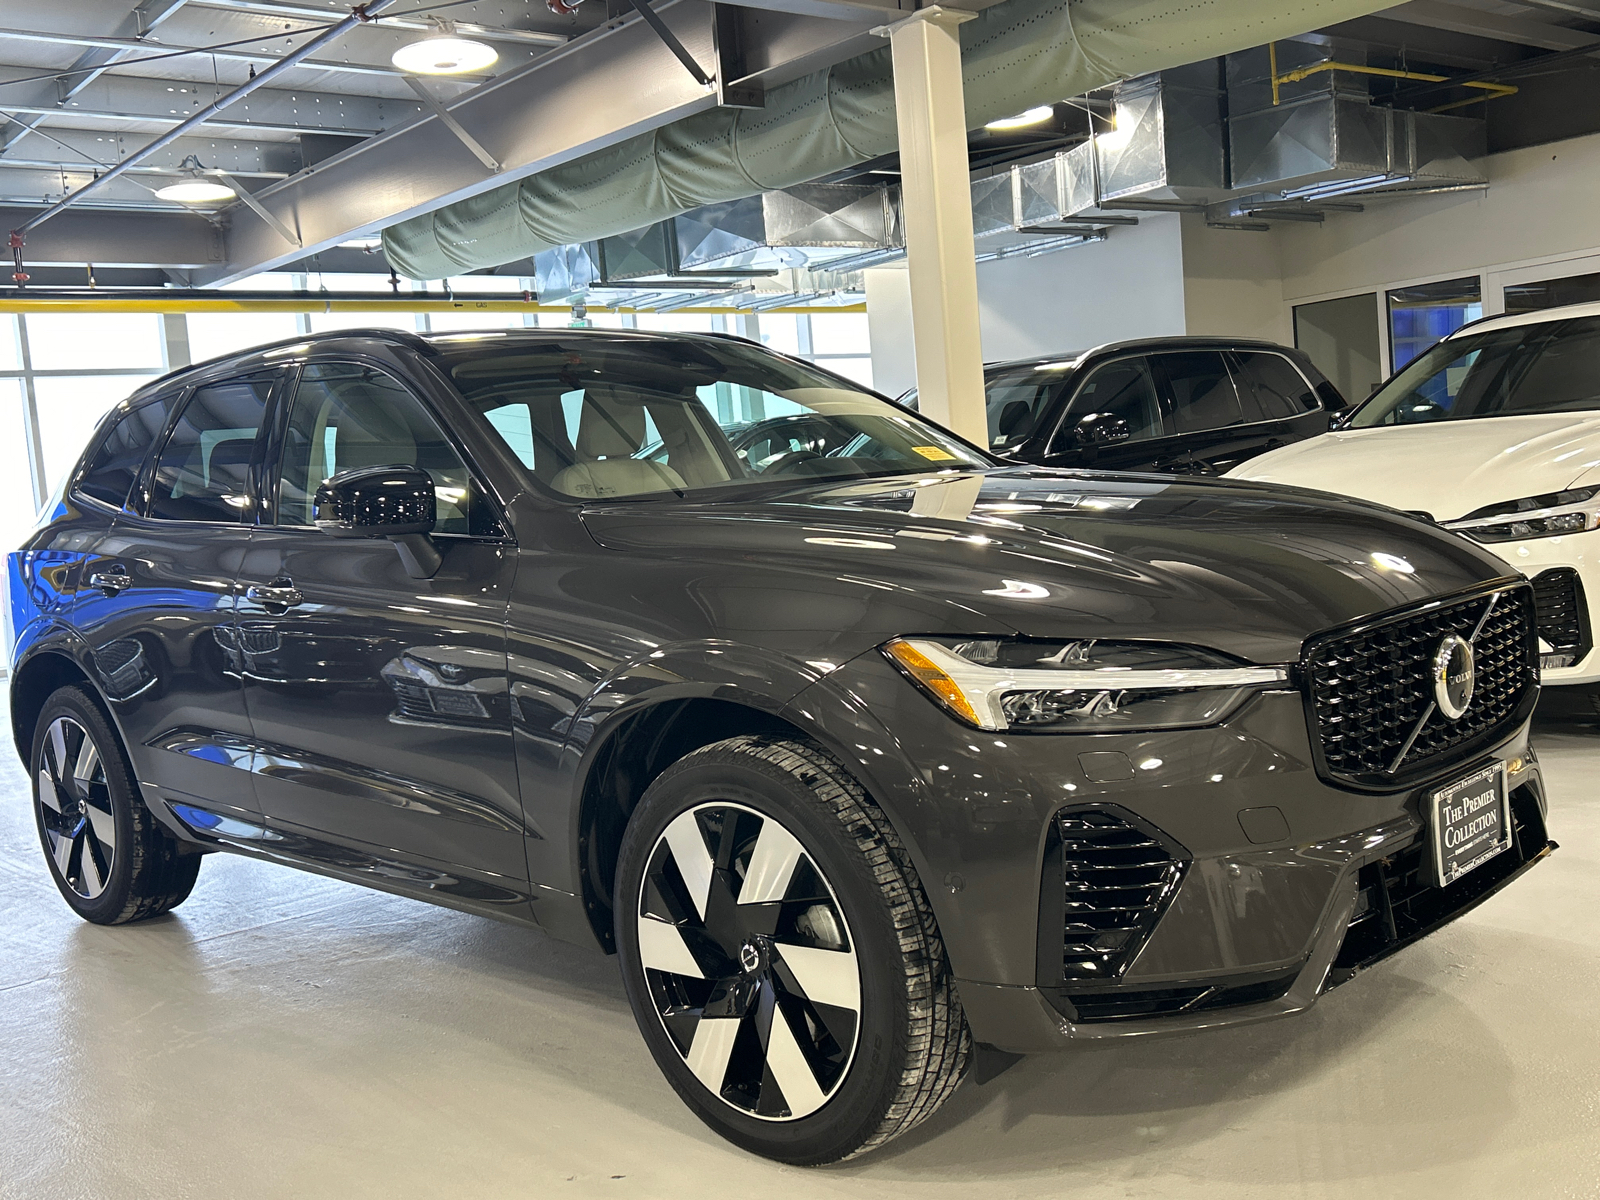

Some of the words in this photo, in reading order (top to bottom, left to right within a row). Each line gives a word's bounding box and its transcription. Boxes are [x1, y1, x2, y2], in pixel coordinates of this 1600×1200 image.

[1443, 805, 1463, 826] THE
[1462, 789, 1496, 817] PREMIER
[1445, 809, 1497, 848] COLLECTION
